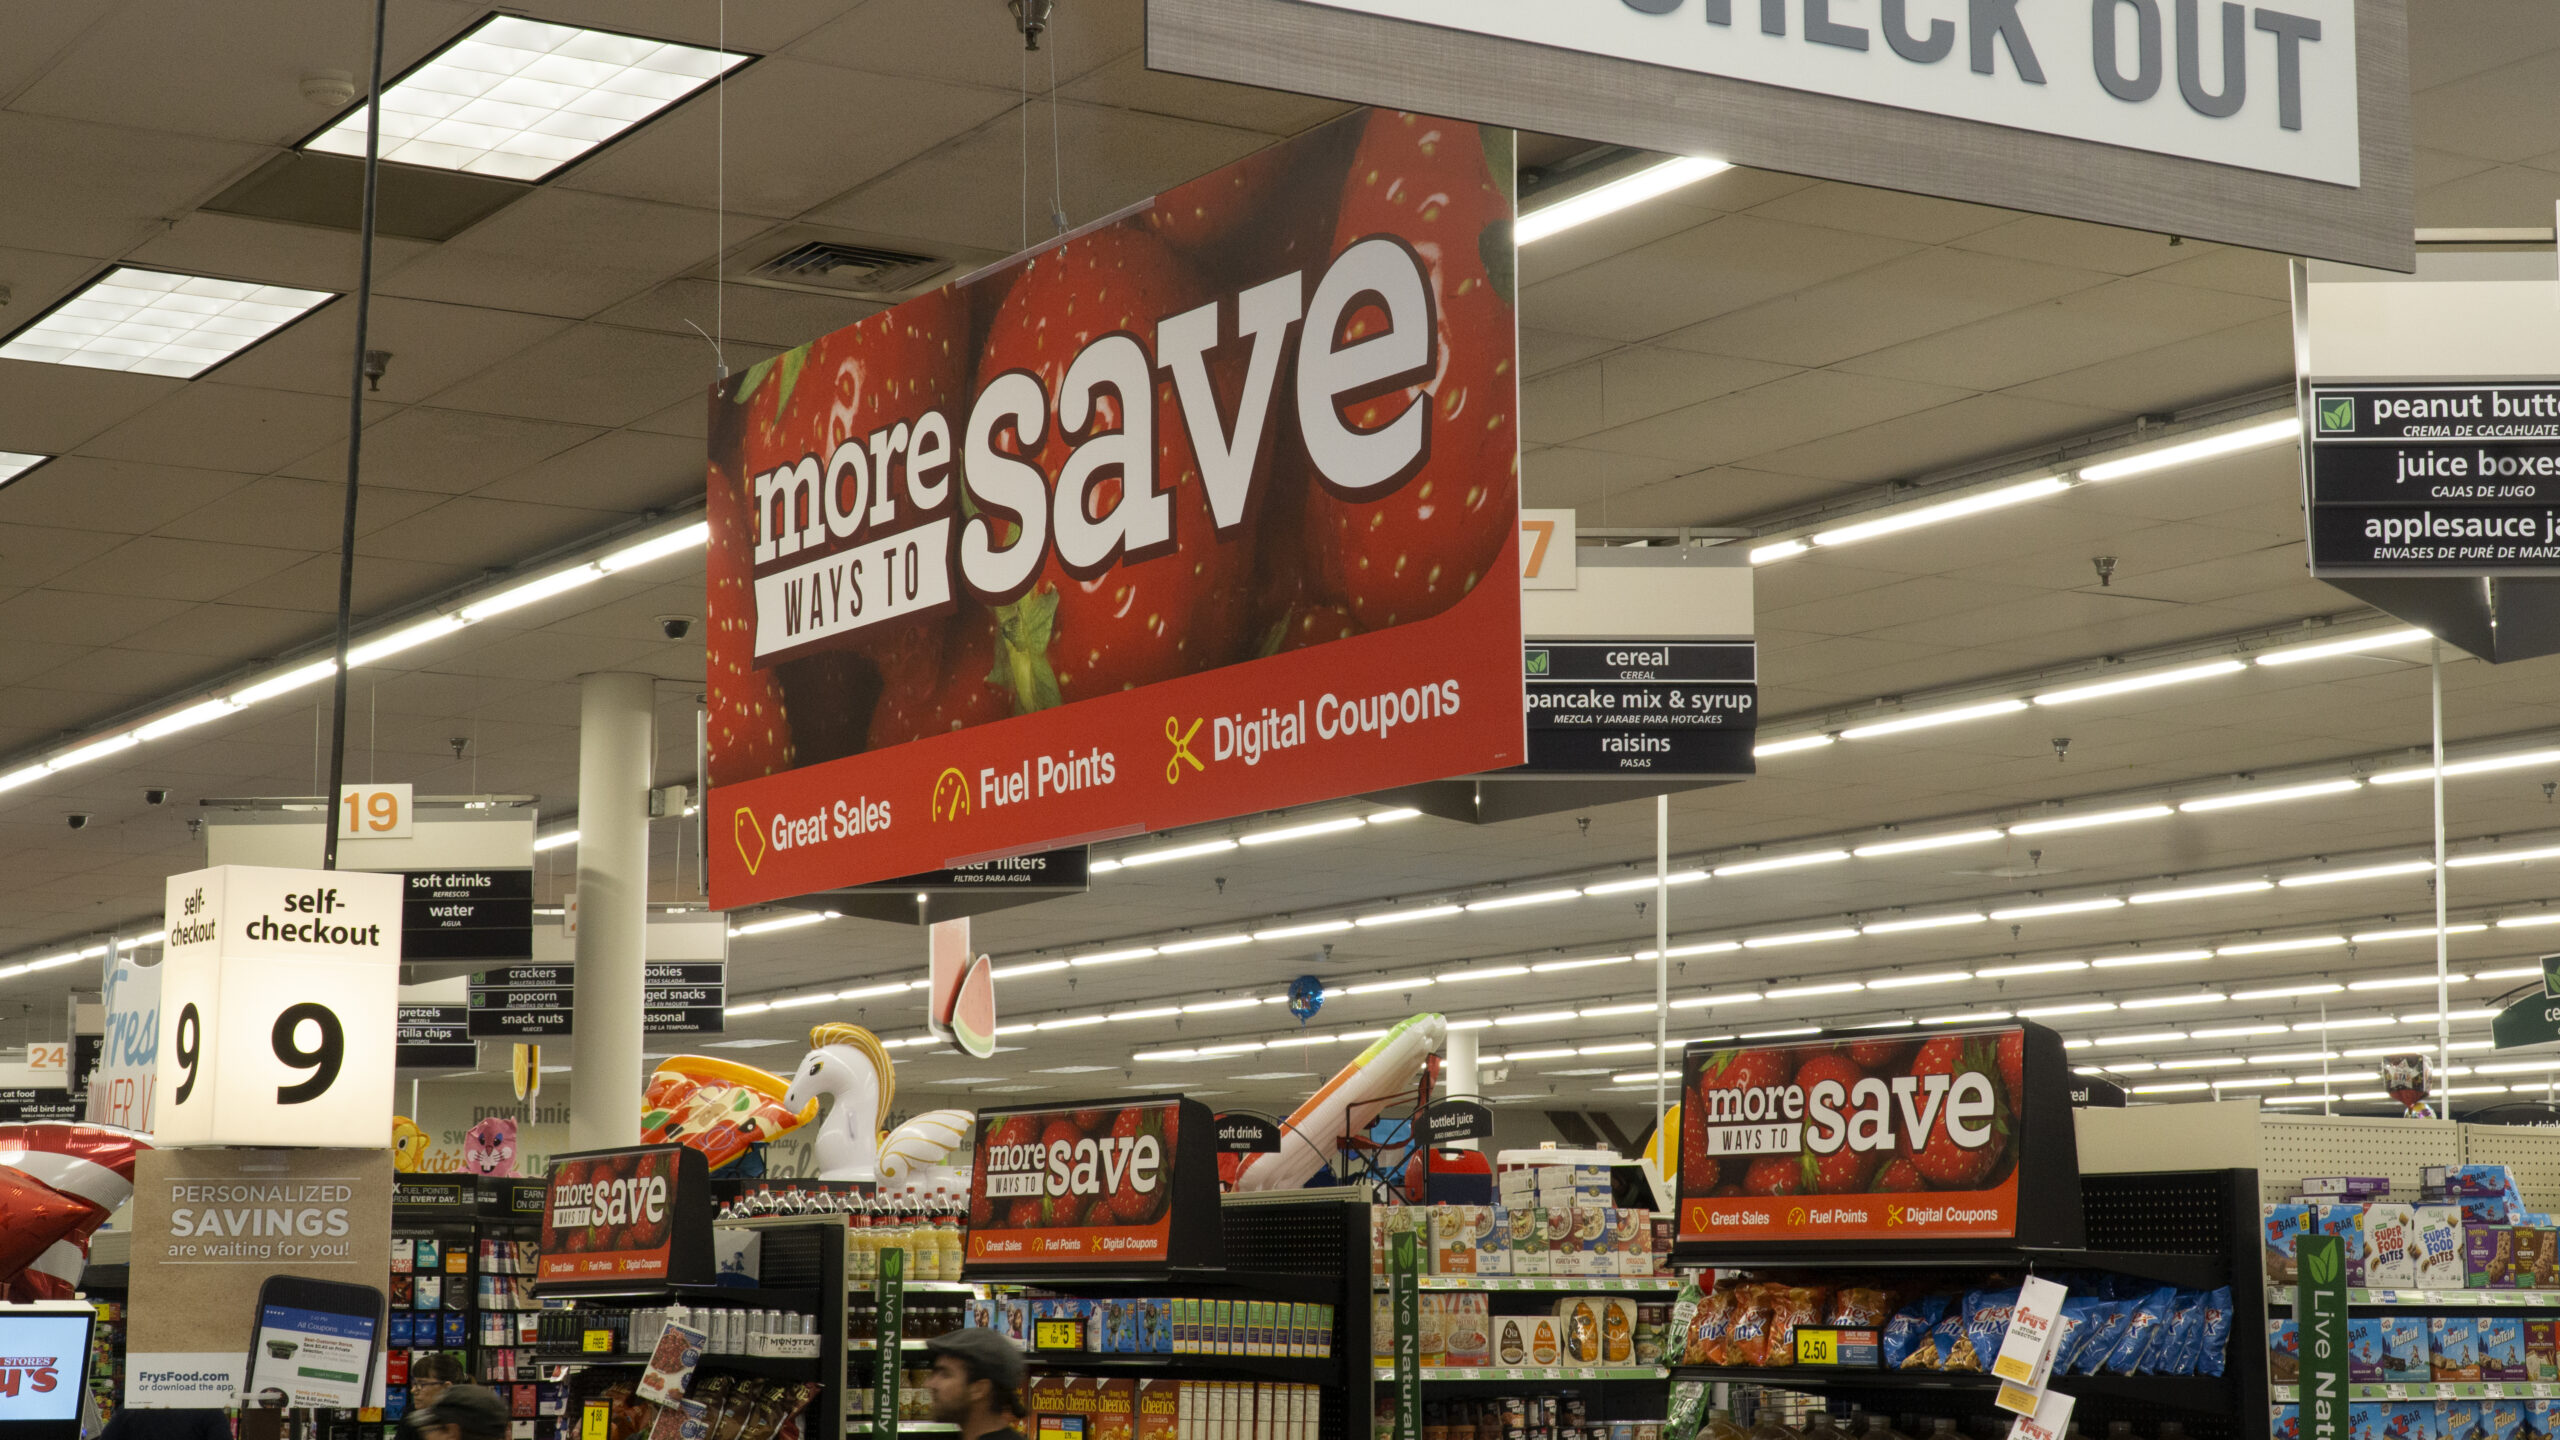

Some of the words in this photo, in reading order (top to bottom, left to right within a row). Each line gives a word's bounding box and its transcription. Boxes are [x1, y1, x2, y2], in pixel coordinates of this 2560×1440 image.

[2093, 0, 2321, 131] OUT
[960, 237, 1437, 594] save
[2373, 393, 2483, 425] peanut
[2492, 391, 2560, 419] butt
[2402, 425, 2451, 438] CREMA
[2454, 425, 2474, 437] DE
[2476, 424, 2559, 437] CACAHUATE
[2396, 451, 2468, 483] juice
[754, 409, 952, 565] more
[2431, 485, 2473, 498] CAJAS
[2476, 485, 2495, 497] DE
[2497, 485, 2536, 498] JUGO
[2364, 511, 2537, 544] applesauce
[1521, 520, 1555, 579] 7
[2373, 547, 2434, 560] ENVASES
[2437, 546, 2456, 559] DE
[2459, 544, 2494, 559] PURÉ
[2497, 546, 2516, 559] DE
[2519, 546, 2560, 559] MANZ
[783, 562, 864, 638] WAYS
[882, 541, 919, 606] TO
[1605, 646, 1670, 667] cereal
[1619, 670, 1656, 681] CEREAL
[1525, 689, 1616, 713] pancake
[1622, 689, 1662, 709] mix
[1668, 690, 1686, 709] &
[1691, 693, 1753, 714] syrup
[1213, 699, 1306, 767] Digital
[1316, 678, 1461, 740] Coupons
[1553, 714, 1593, 725] MEZCLA
[1595, 714, 1602, 724] Y
[1603, 714, 1641, 725] JARABE
[1642, 714, 1669, 724] PARA
[1670, 714, 1723, 724] HOTCAKES
[1601, 732, 1671, 753] raisins
[1619, 758, 1652, 768] PASAS
[979, 760, 1029, 809] Fuel
[1037, 746, 1117, 798] Points
[343, 792, 399, 833] 19
[771, 810, 828, 852] Great
[833, 796, 892, 840] Sales
[412, 874, 442, 888] soft
[445, 873, 492, 888] drinks
[953, 874, 984, 883] FILTROS
[984, 874, 1006, 882] PARA
[1007, 874, 1031, 882] AGUA
[184, 888, 206, 916] self-
[283, 888, 347, 914] self-
[432, 890, 470, 898] REFRESCOS
[429, 905, 475, 917] water
[171, 915, 216, 948] checkout
[246, 915, 381, 947] checkout
[440, 920, 462, 928] AGUA
[508, 967, 558, 979] crackers
[645, 966, 683, 977] ookies
[508, 992, 558, 1004] popcorn
[669, 988, 706, 1000] snacks
[399, 1007, 441, 1019] pretzels
[501, 1012, 536, 1025] snack
[538, 1014, 564, 1024] nuts
[643, 1010, 686, 1022] easonal
[398, 1028, 422, 1038] rtilla
[424, 1027, 452, 1039] chips
[31, 1046, 67, 1069] 24
[175, 1002, 201, 1106] 9
[270, 1002, 345, 1106] 9
[3, 1090, 15, 1098] cat
[16, 1090, 36, 1098] food
[20, 1105, 38, 1113] wild
[39, 1105, 56, 1113] bird
[57, 1104, 76, 1112] seed
[1707, 1084, 1803, 1123] more
[1429, 1114, 1455, 1129] bottled
[1455, 1112, 1474, 1128] juice
[1805, 1071, 1995, 1154] save
[1218, 1127, 1236, 1139] soft
[1236, 1127, 1263, 1140] drinks
[1433, 1131, 1445, 1140] JUGO
[1722, 1130, 1762, 1151] WAYS
[1771, 1128, 1788, 1149] TO
[987, 1142, 1046, 1172] more
[1046, 1134, 1161, 1197] save
[402, 1187, 420, 1195] FUEL
[422, 1187, 449, 1195] POINTS
[995, 1176, 1020, 1194] WAYS
[1024, 1175, 1037, 1193] TO
[171, 1185, 352, 1203] PERSONALIZED
[523, 1190, 545, 1199] EARN
[554, 1182, 594, 1207] more
[591, 1175, 667, 1228] save
[516, 1200, 527, 1209] ON
[169, 1207, 350, 1237] SAVINGS
[558, 1211, 575, 1225] WAYS
[577, 1210, 586, 1224] TO
[1711, 1211, 1740, 1226] Great
[1741, 1210, 1770, 1225] Sales
[1809, 1209, 1833, 1224] Fuel
[1834, 1208, 1868, 1224] Points
[1906, 1206, 1943, 1226] Digital
[1945, 1207, 1998, 1225] Coupons
[2374, 1225, 2402, 1242] SUPER
[2423, 1226, 2452, 1244] SUPER
[167, 1243, 198, 1257] are
[203, 1241, 272, 1260] waiting
[277, 1241, 304, 1257] for
[309, 1241, 350, 1260] you!
[986, 1240, 1004, 1252] Great
[1005, 1239, 1022, 1252] Sales
[1045, 1238, 1060, 1250] Fuel
[1060, 1238, 1081, 1251] Points
[1103, 1237, 1125, 1251] Digital
[1126, 1237, 1158, 1251] Coupons
[2377, 1237, 2404, 1254] FOOD
[2426, 1239, 2454, 1256] FOOD
[2379, 1249, 2404, 1265] BITES
[2429, 1250, 2455, 1266] BITES
[885, 1281, 898, 1324] Live
[1400, 1274, 1413, 1327] Live
[1052, 1323, 1057, 1333] 2
[2019, 1326, 2037, 1336] STORE
[2314, 1290, 2336, 1359] Live
[770, 1337, 815, 1347] MONSTER
[1050, 1334, 1059, 1344] for
[2011, 1329, 2042, 1343] DIRECTORY
[1803, 1340, 1827, 1360] 2.50
[3, 1357, 51, 1366] STORES
[139, 1371, 230, 1384] FrysFood.com
[878, 1331, 896, 1433] Naturally
[151, 1382, 198, 1392] download
[198, 1382, 214, 1391] the
[215, 1384, 236, 1394] app.
[1032, 1394, 1065, 1411] Cheerios
[1064, 1395, 1097, 1413] Cheerios
[1098, 1396, 1131, 1414] Cheerios
[1141, 1396, 1176, 1415] Cheerios
